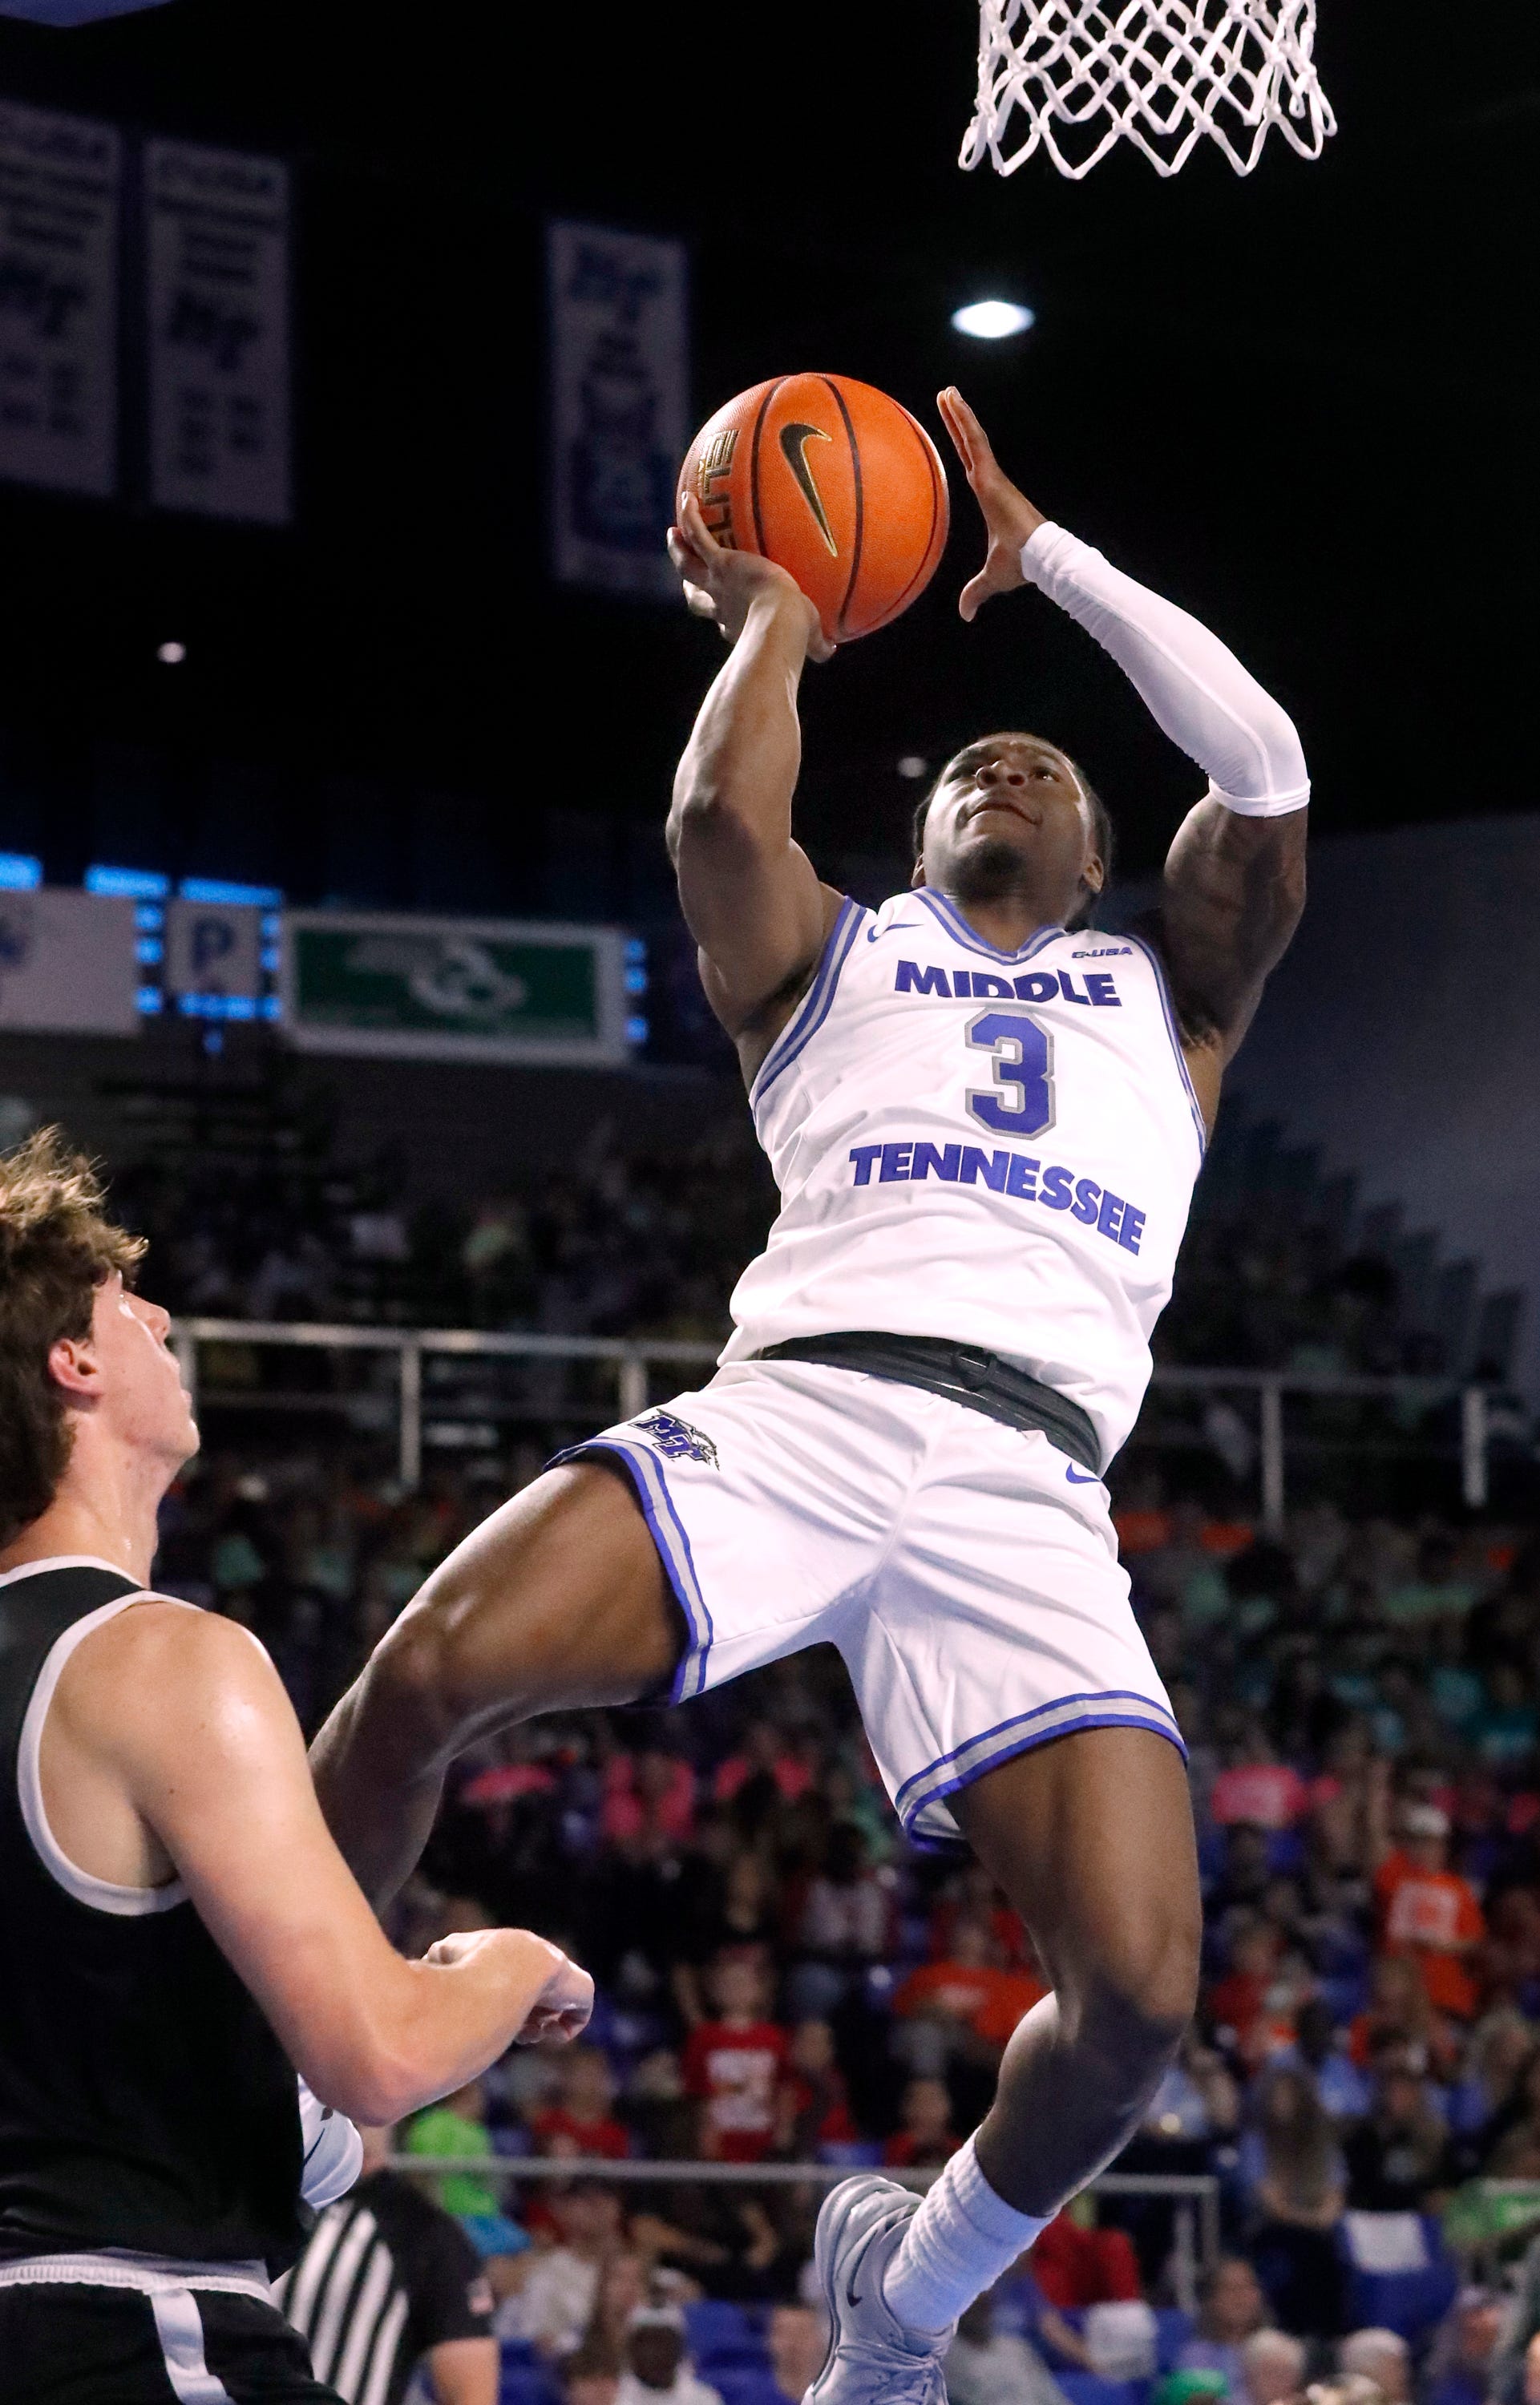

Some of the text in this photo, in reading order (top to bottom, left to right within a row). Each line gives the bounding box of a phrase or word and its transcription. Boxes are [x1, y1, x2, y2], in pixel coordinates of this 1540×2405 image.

[895, 960, 1122, 1007] MIDDLE
[1072, 947, 1133, 959] C-USA
[964, 1007, 1056, 1140] 3
[849, 1142, 1146, 1256] TENNESSEE
